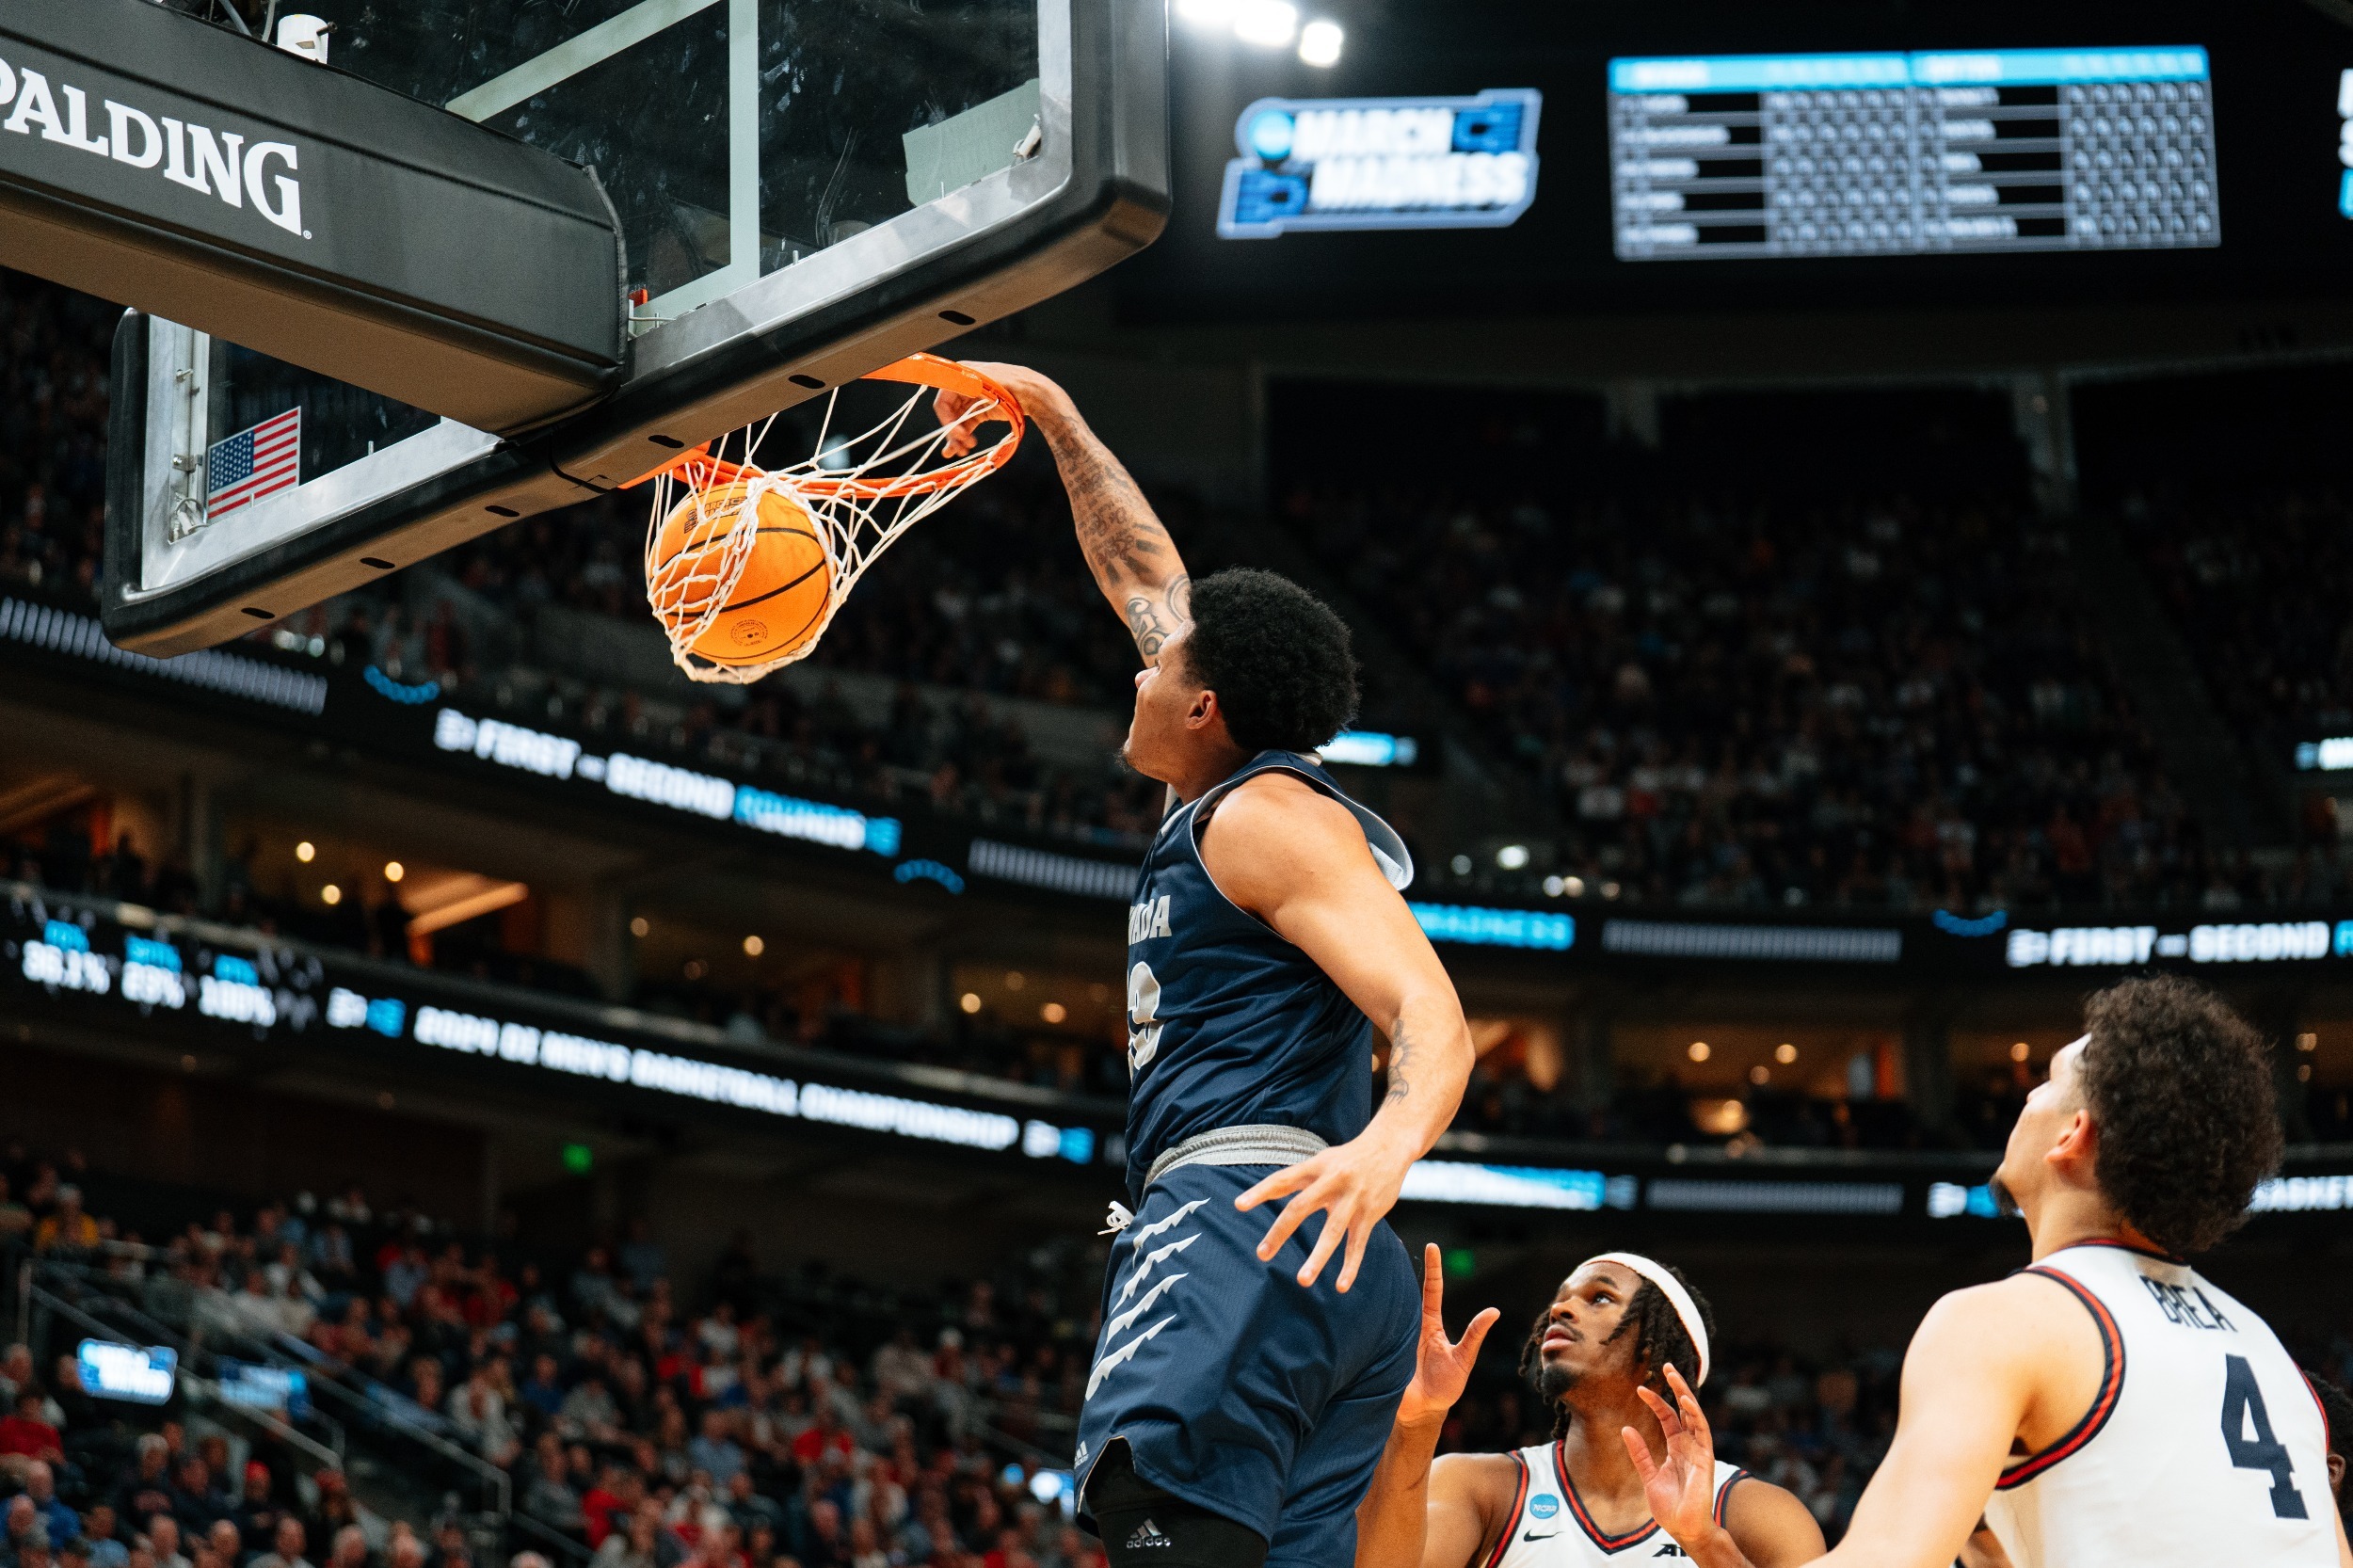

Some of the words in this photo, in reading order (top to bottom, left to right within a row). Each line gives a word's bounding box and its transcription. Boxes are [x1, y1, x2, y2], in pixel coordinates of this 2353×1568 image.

[2189, 921, 2329, 963] SECOND
[2139, 1275, 2238, 1332] BREA
[2221, 1353, 2310, 1520] 4
[1127, 1536, 1172, 1548] adidas
